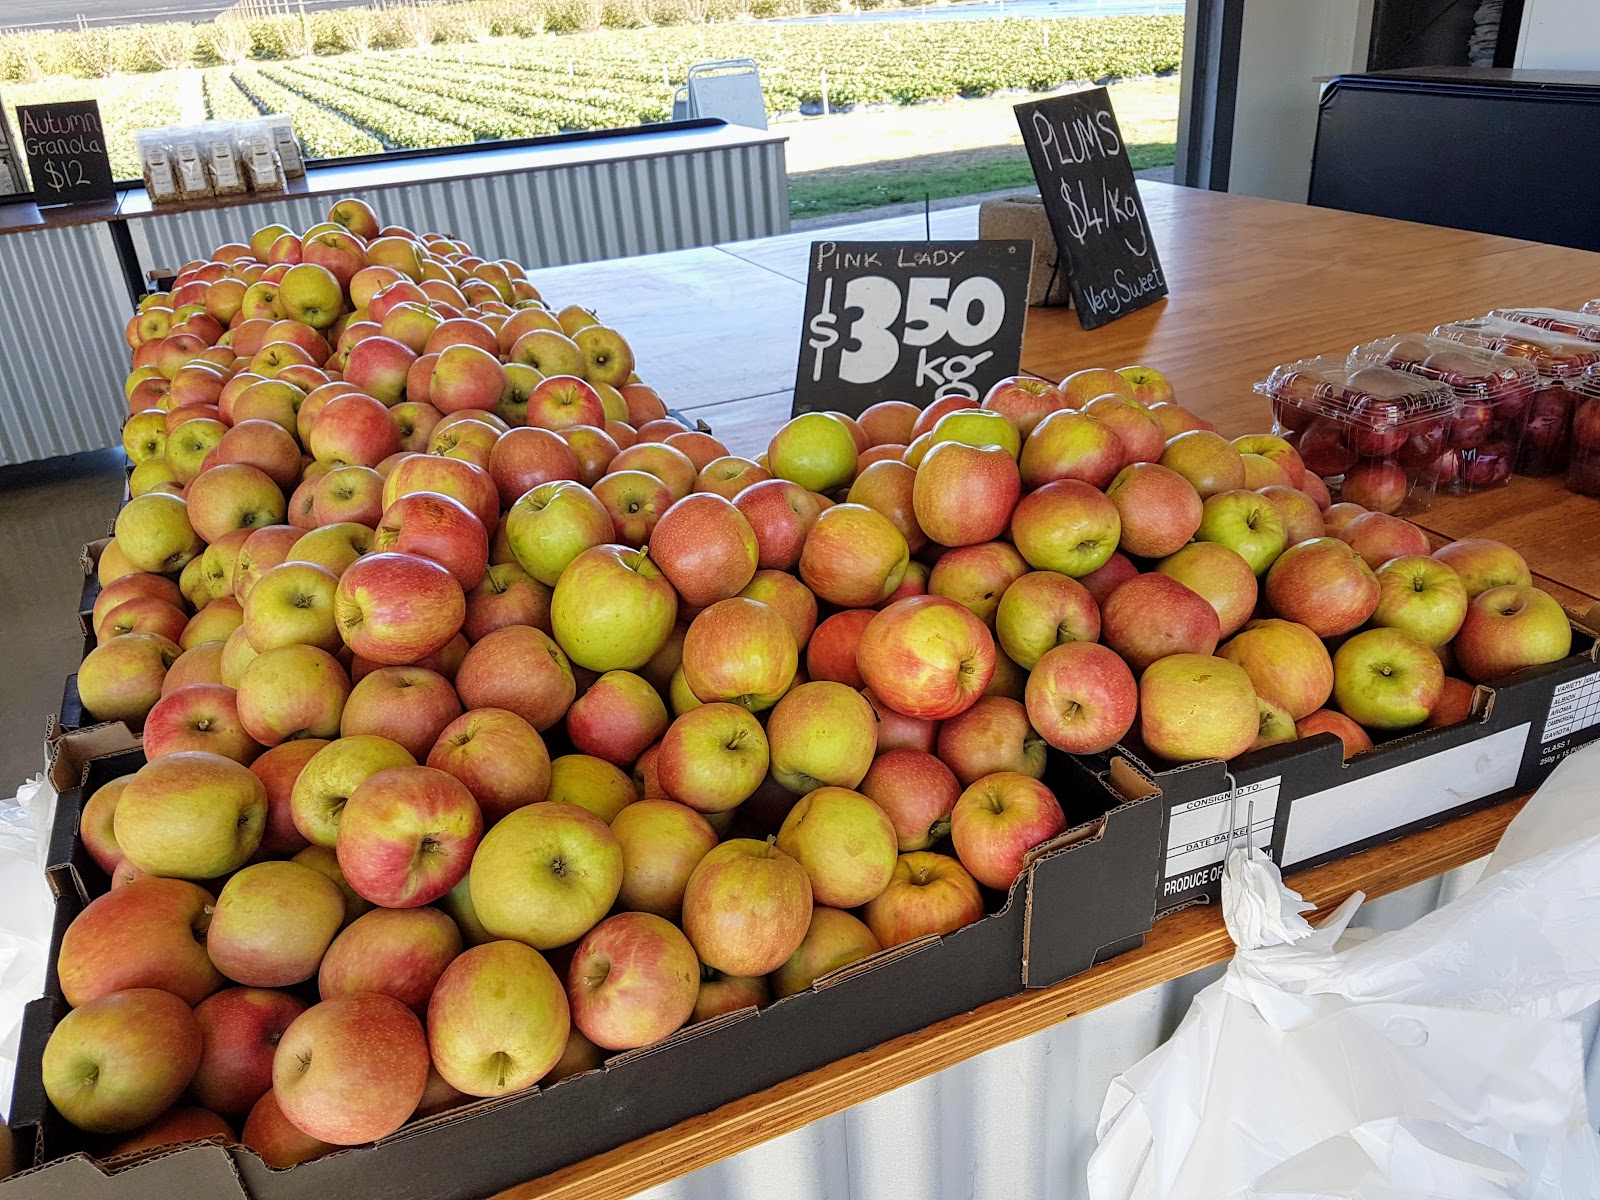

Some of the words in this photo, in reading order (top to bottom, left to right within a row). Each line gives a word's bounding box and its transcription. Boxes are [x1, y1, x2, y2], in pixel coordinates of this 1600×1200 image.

[23, 109, 100, 136] Autumn
[25, 135, 103, 156] Granola
[1032, 110, 1120, 171] PLUMS
[43, 158, 91, 192] $12
[817, 241, 882, 271] PINK
[898, 249, 965, 267] LADY
[1083, 285, 1119, 315] Very
[1113, 259, 1164, 304] Sweet
[915, 347, 994, 402] kg
[1557, 679, 1583, 693] VARIETY
[1550, 705, 1572, 716] AROMA
[1554, 693, 1576, 705] ALBION
[1544, 727, 1570, 740] GAVIOTA
[1542, 740, 1566, 754] CLASS
[1539, 755, 1556, 766] 250g
[1186, 788, 1244, 809] CONSIGND
[1247, 783, 1262, 793] TO:
[1186, 839, 1212, 852] DATE
[1163, 869, 1209, 897] PRODUCE
[1210, 864, 1224, 882] OF
